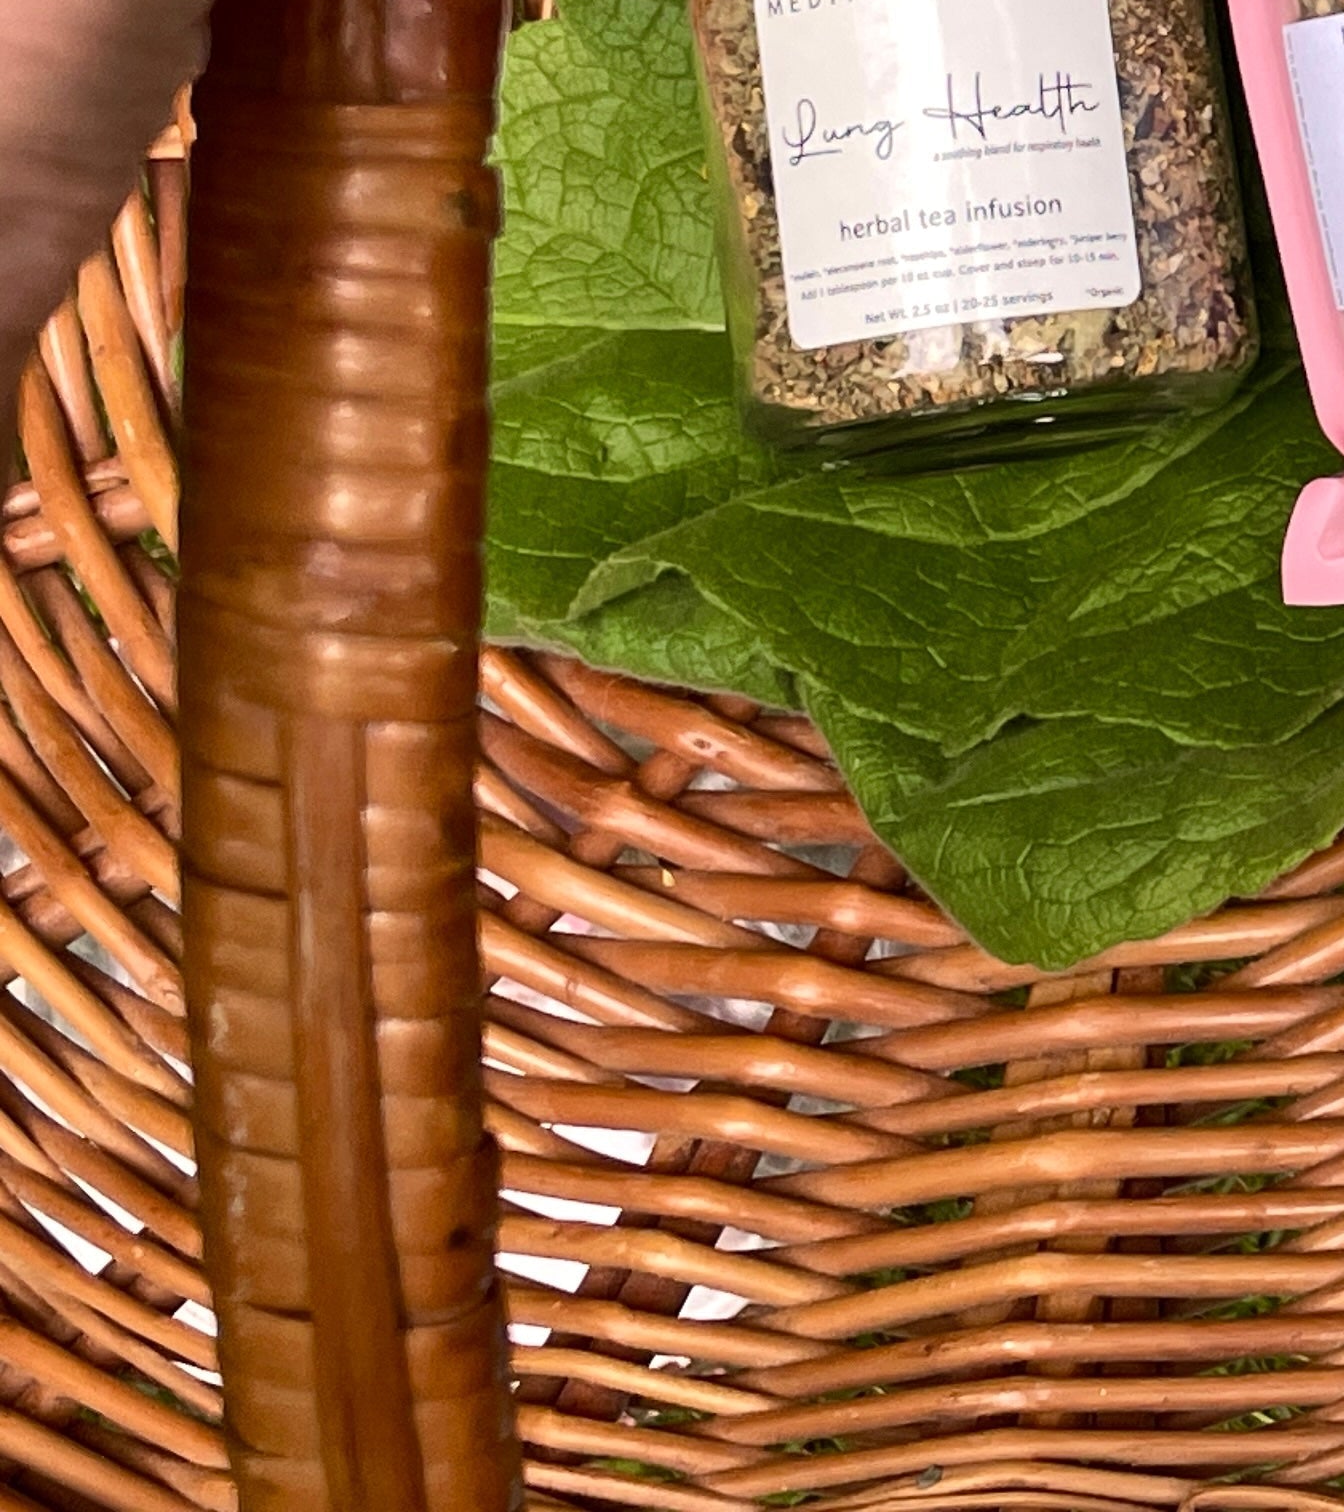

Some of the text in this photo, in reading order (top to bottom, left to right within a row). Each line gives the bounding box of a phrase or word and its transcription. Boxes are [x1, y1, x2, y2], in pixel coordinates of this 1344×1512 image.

[783, 71, 1100, 166] Lung Health
[840, 194, 1063, 241] herbal tea infusion
[958, 262, 990, 276] Cover
[994, 259, 1014, 271] and
[1002, 291, 1053, 305] servings
